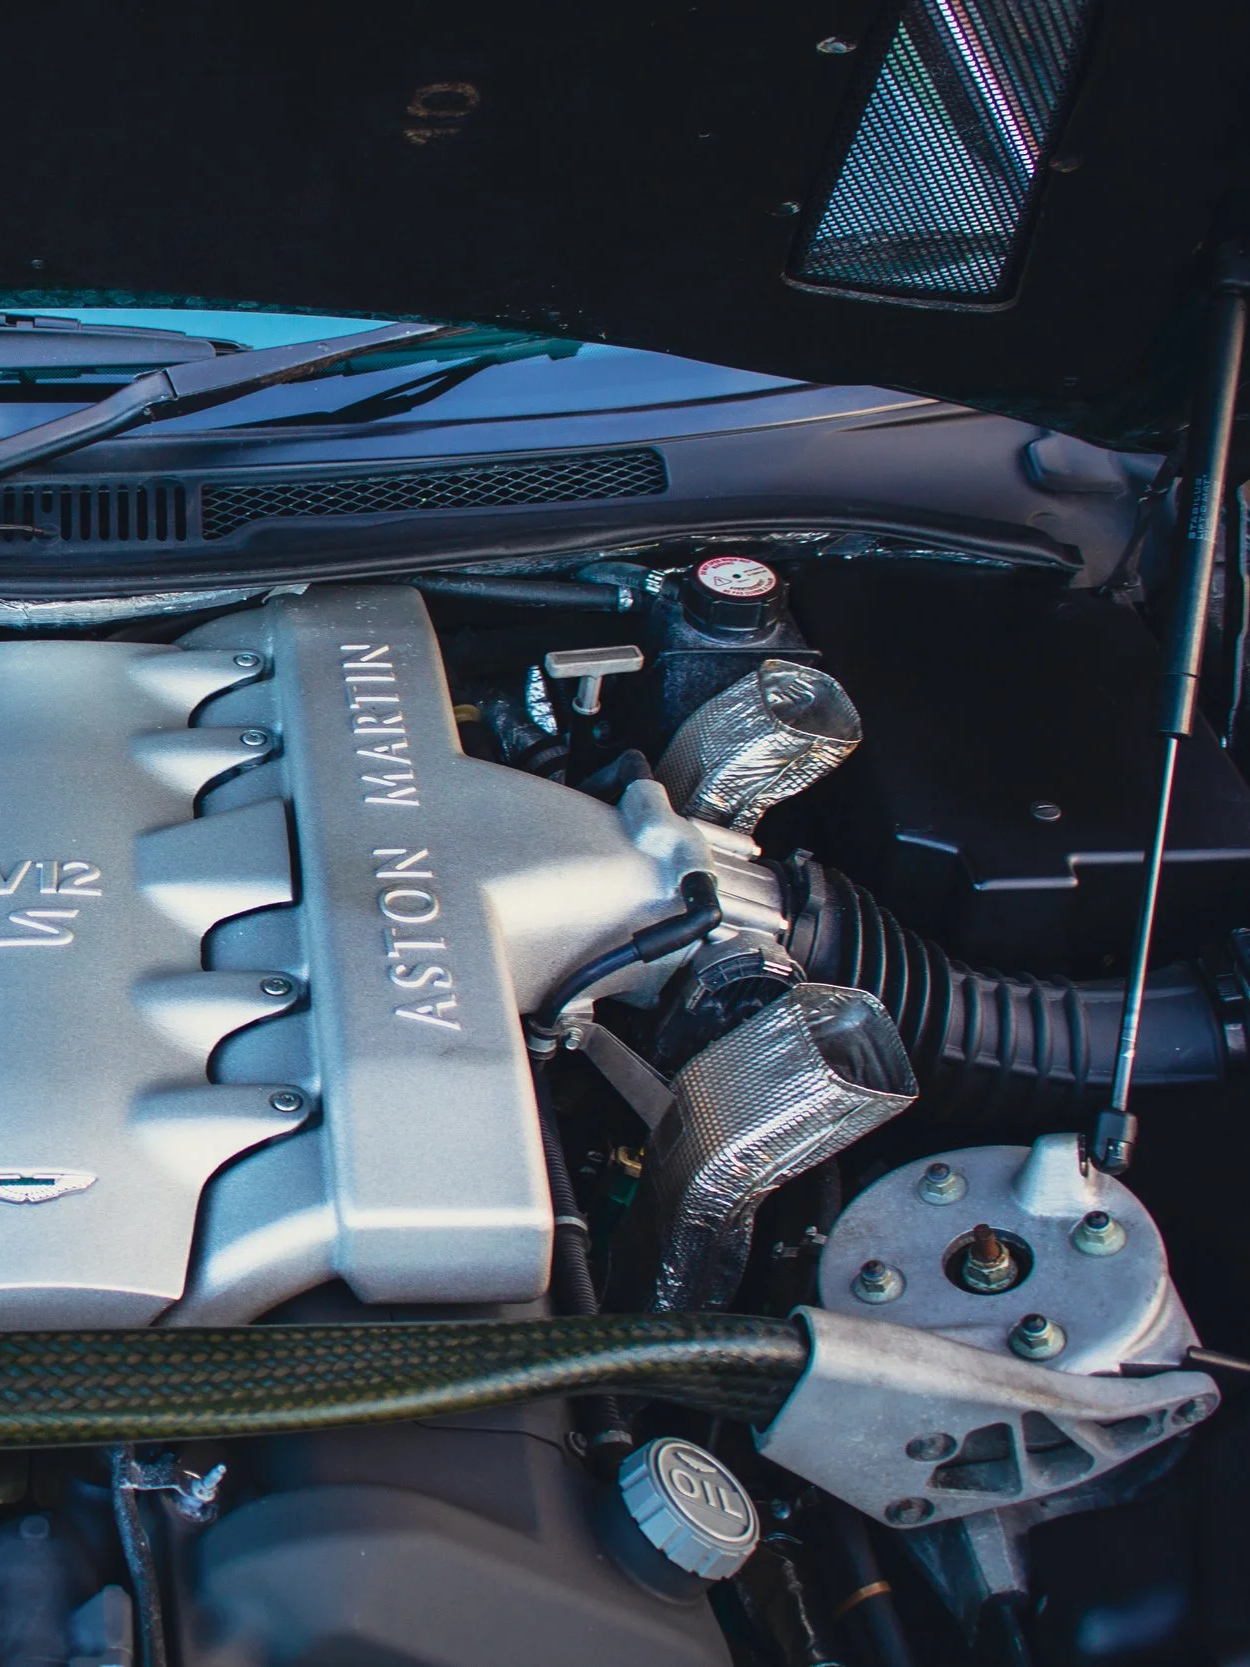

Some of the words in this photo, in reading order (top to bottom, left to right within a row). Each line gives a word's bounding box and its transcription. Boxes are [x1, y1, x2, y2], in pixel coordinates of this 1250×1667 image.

[340, 644, 421, 806] MARTIN
[372, 848, 462, 1031] ASTON
[669, 1468, 744, 1519] OIL
